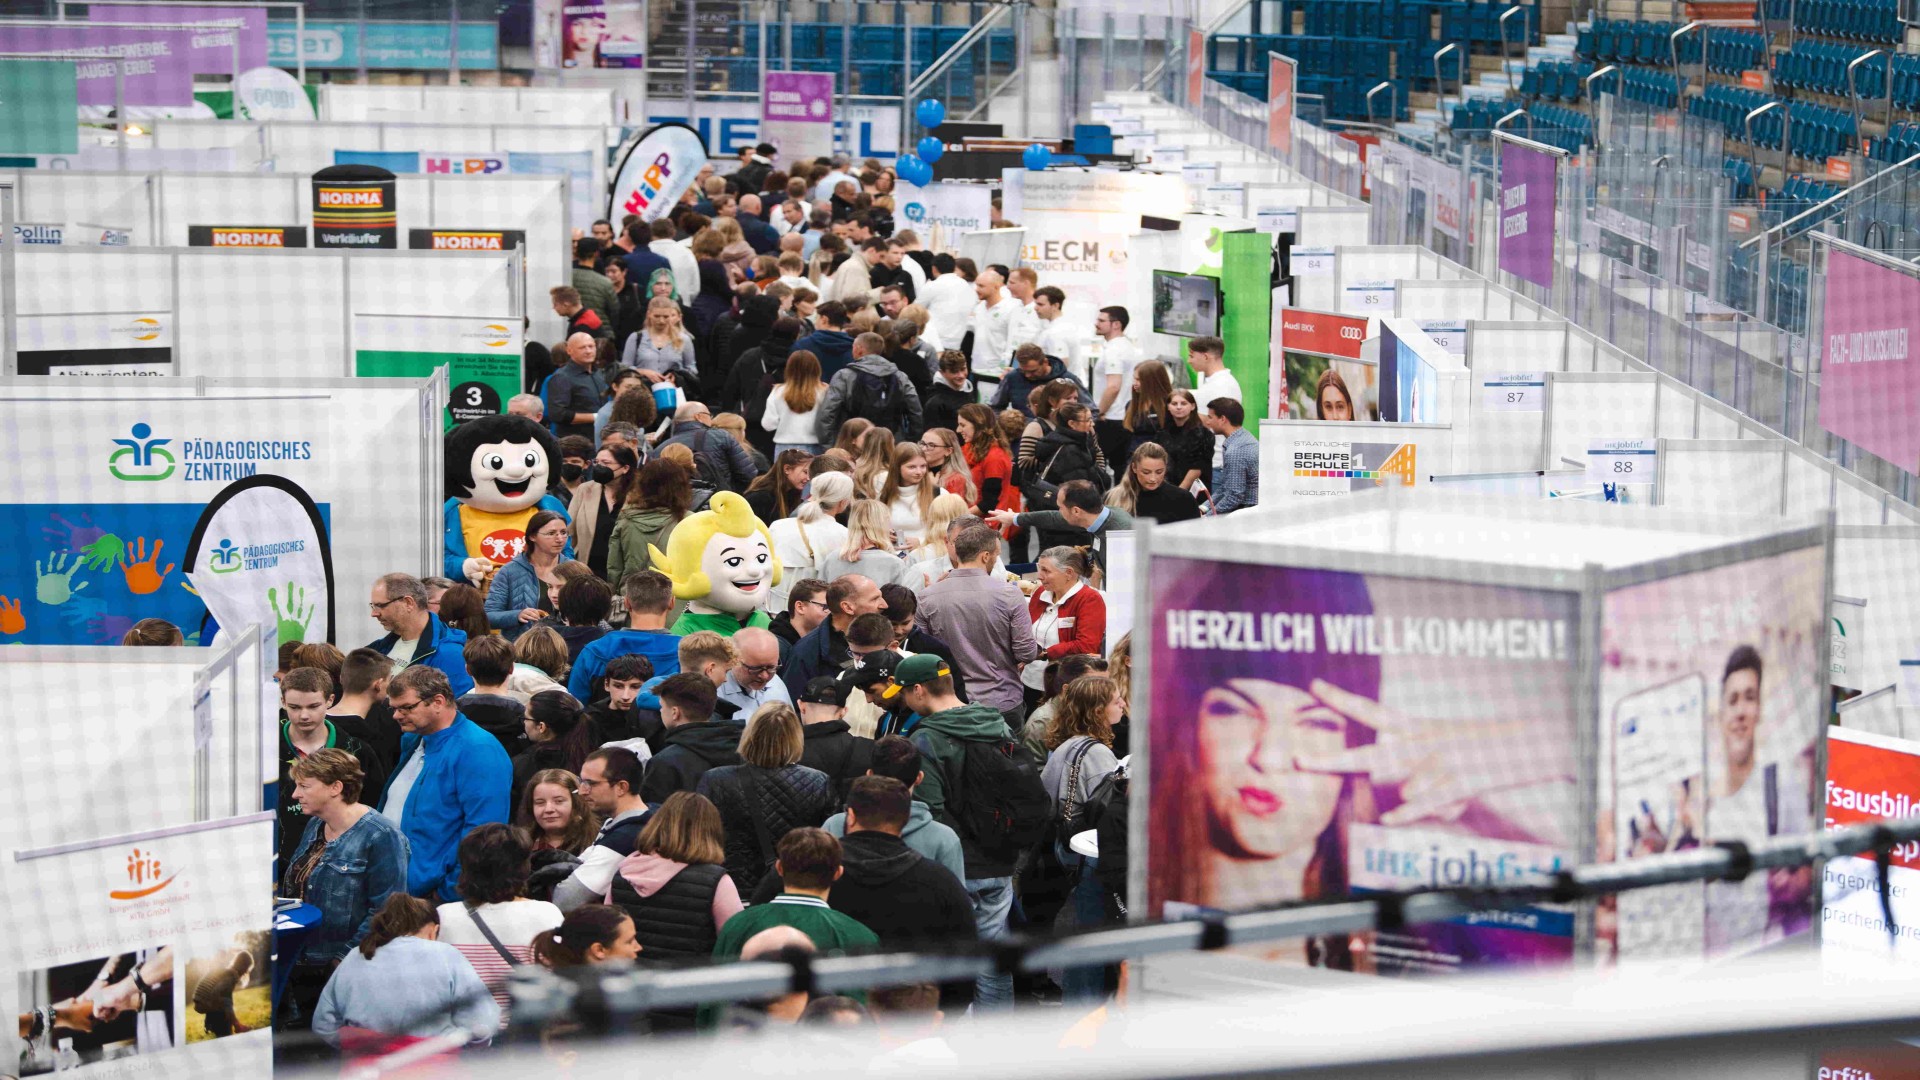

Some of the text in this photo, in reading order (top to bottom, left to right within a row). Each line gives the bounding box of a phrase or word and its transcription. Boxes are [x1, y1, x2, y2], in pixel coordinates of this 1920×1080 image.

[319, 191, 381, 205] NORMA
[213, 232, 281, 246] NORMA
[322, 232, 382, 244] Verkäufer
[433, 236, 501, 249] NORMA
[1044, 240, 1099, 262] ECM
[1307, 259, 1321, 269] 84
[1364, 294, 1379, 305] 85
[1284, 321, 1315, 334] Audi BKK
[466, 386, 483, 406] 3
[1506, 391, 1525, 403] 87
[183, 437, 312, 460] PÄDAGOGISCHES
[1294, 452, 1350, 461] BERUFS
[1294, 453, 1367, 470] SCHULE 1
[184, 462, 257, 482] ZENTRUM
[1613, 460, 1633, 474] 88
[243, 539, 305, 558] PÄDAGOGISCHES
[244, 556, 279, 572] ZENTRUM
[1165, 608, 1569, 661] HERZLICH WILLKOMMEN!
[1837, 872, 1908, 899] geprüter
